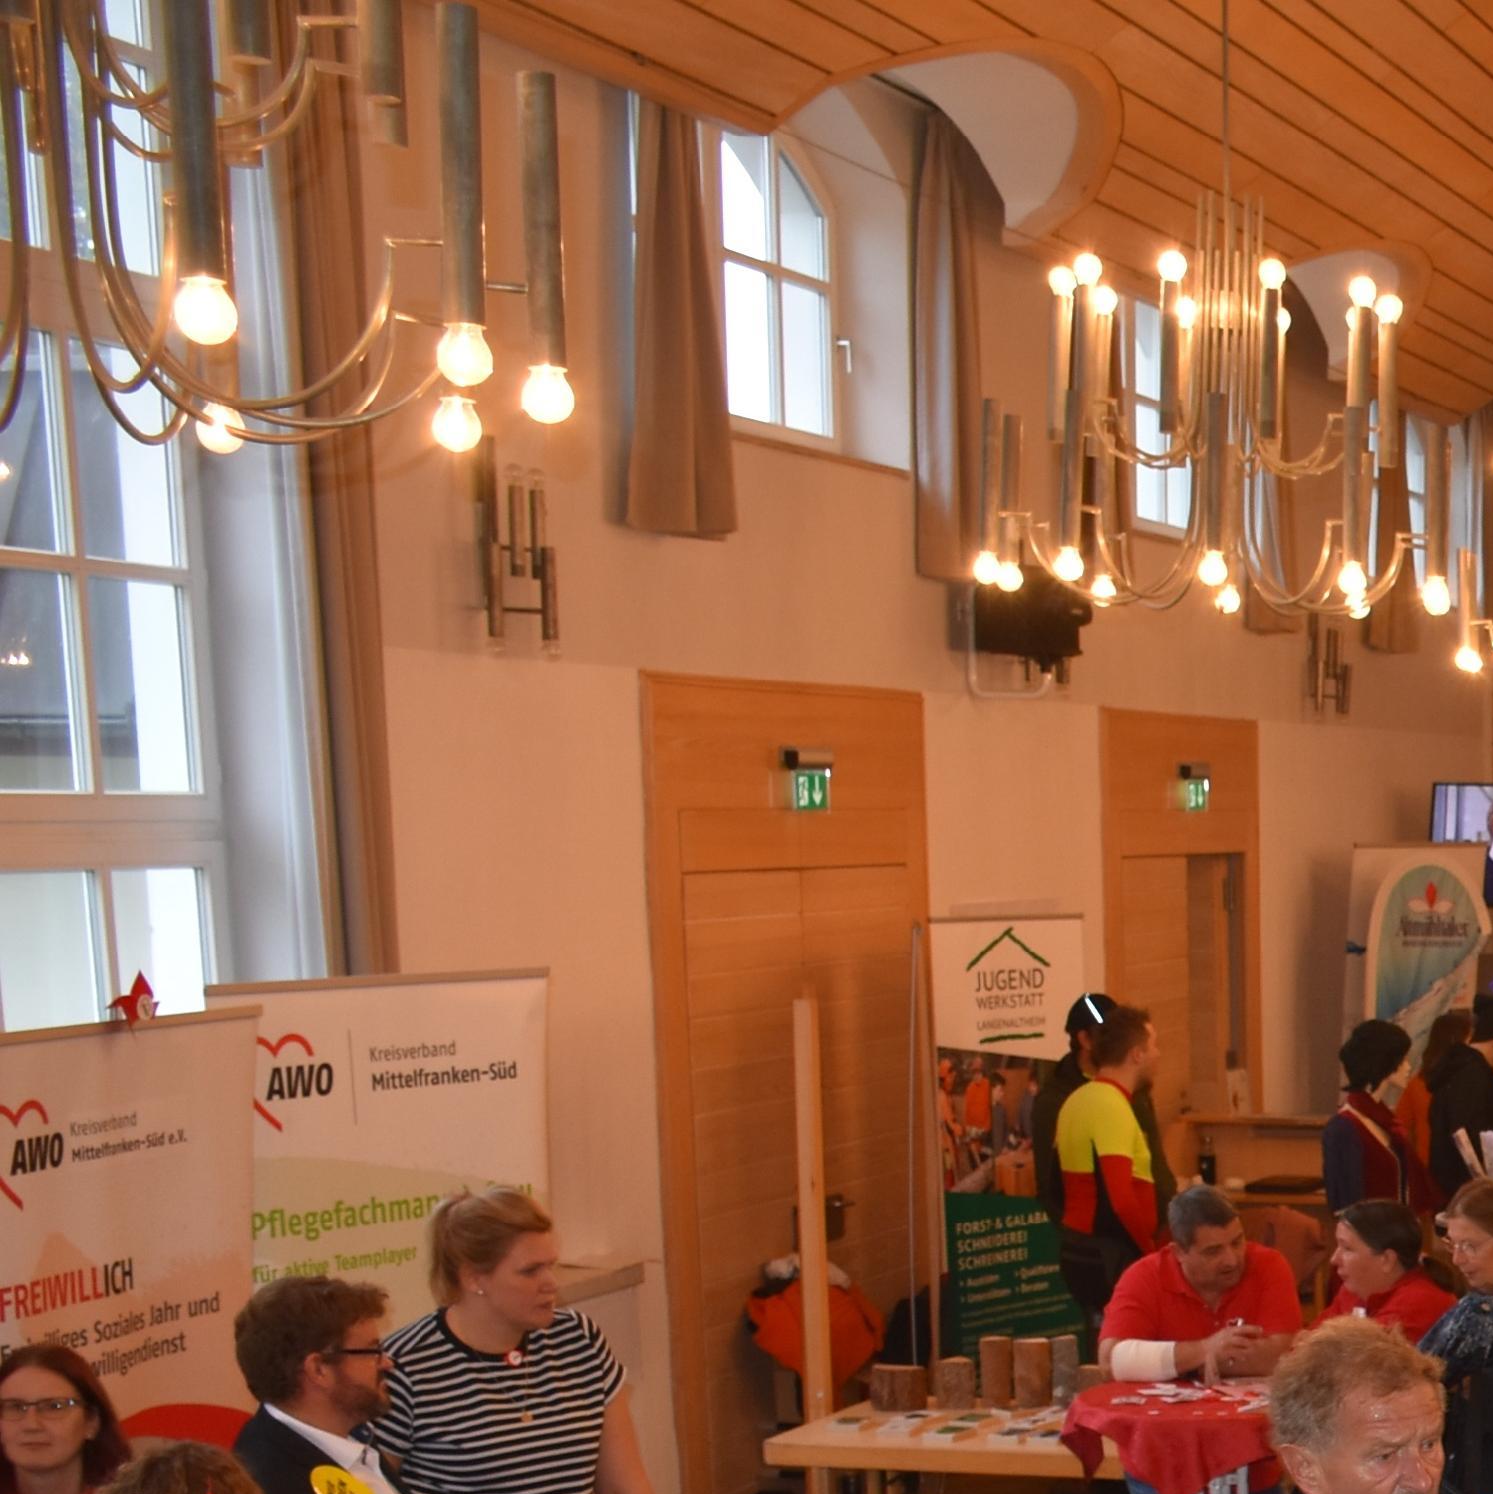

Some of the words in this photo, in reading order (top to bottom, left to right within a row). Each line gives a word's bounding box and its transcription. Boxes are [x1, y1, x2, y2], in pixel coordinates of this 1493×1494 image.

[976, 968, 1045, 992] JUGEND
[976, 993, 1045, 1010] WERKSTATT
[369, 1042, 456, 1062] Kreisverband
[267, 1063, 334, 1101] AWO
[371, 1062, 518, 1092] Mittelfranken-Süd
[69, 1112, 137, 1137] Kreisverband
[10, 1132, 64, 1176] AWO
[72, 1133, 165, 1162] Mittelfranken-Süd
[335, 1246, 417, 1273] Teamplayer
[0, 1257, 135, 1323] FREIWILLICH
[94, 1309, 146, 1345] Soziales
[149, 1299, 182, 1326] Jahr
[188, 1290, 220, 1318] und
